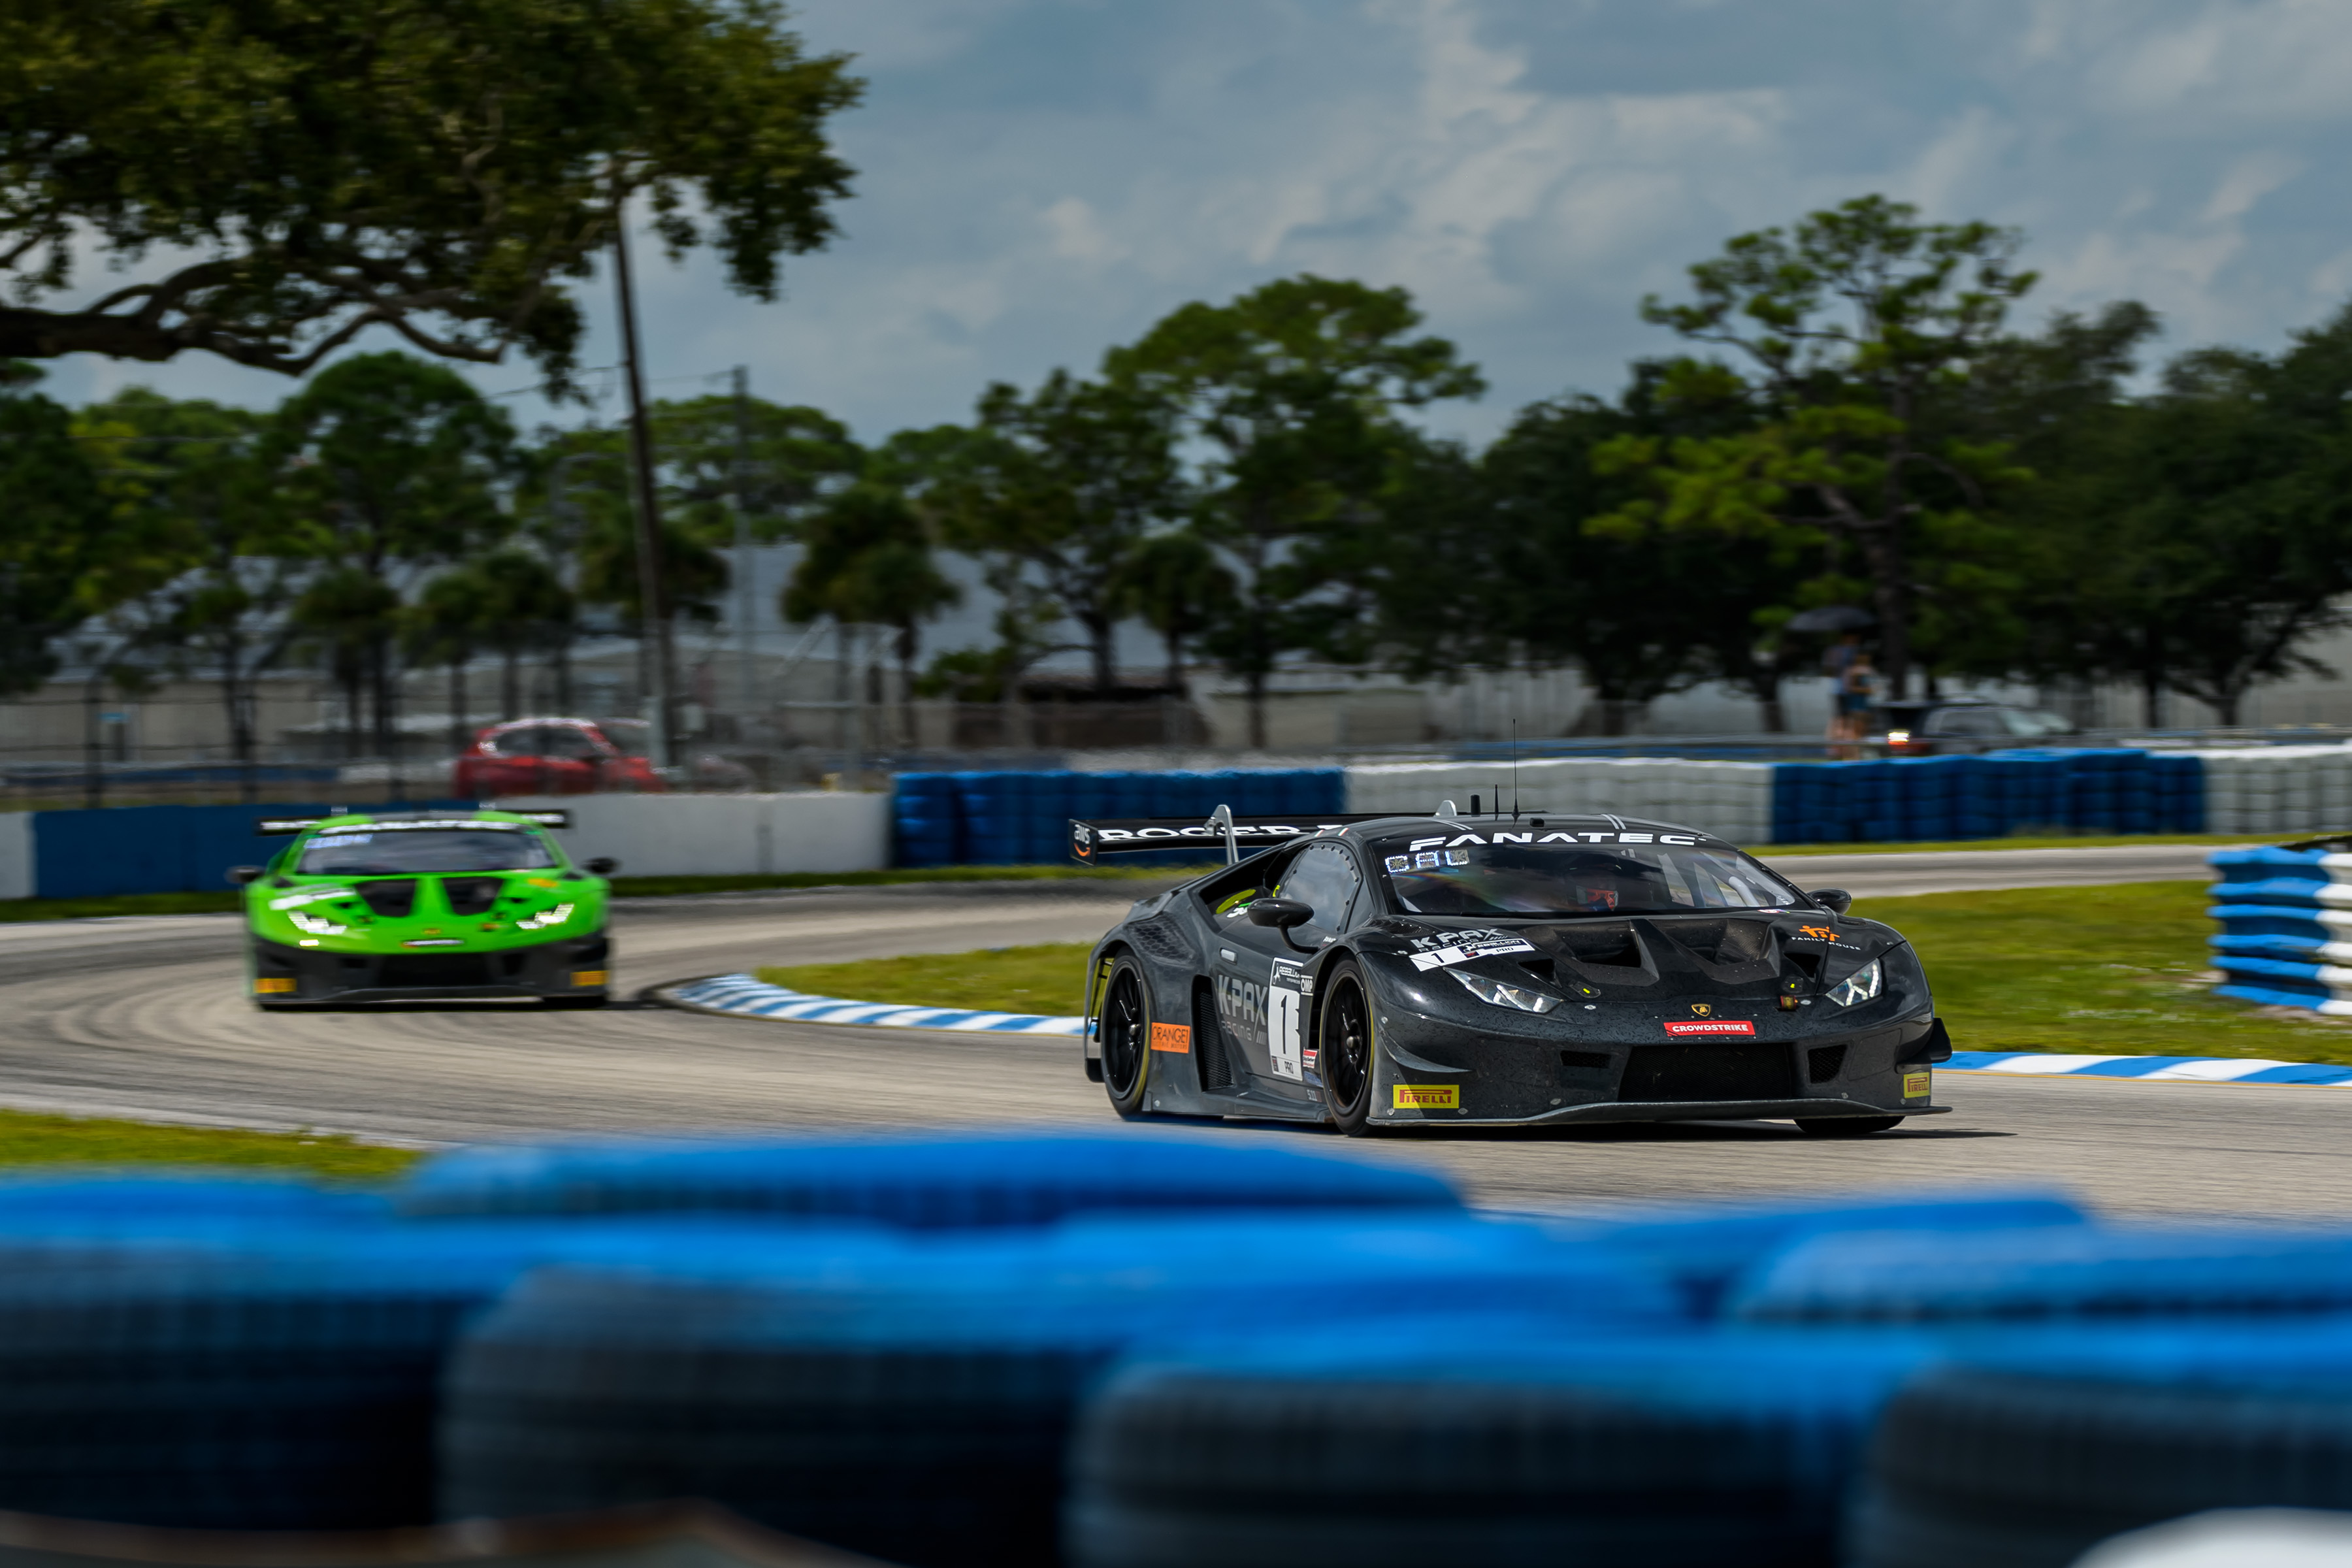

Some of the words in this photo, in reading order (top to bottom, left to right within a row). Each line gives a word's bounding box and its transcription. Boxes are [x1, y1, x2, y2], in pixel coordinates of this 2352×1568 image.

[1075, 825, 1090, 844] aws
[1098, 825, 1309, 841] ROGER
[1409, 832, 1695, 851] FANATEC
[1828, 941, 1861, 951] HOUSE
[1431, 953, 1445, 964] 1
[1301, 979, 1313, 992] OMP
[1218, 974, 1268, 1037] K-PAX
[1281, 994, 1288, 1055] 1
[1672, 1024, 1749, 1032] CROWDSTRIKE
[1284, 1060, 1294, 1075] PRO
[1399, 1089, 1452, 1103] PIRELLI
